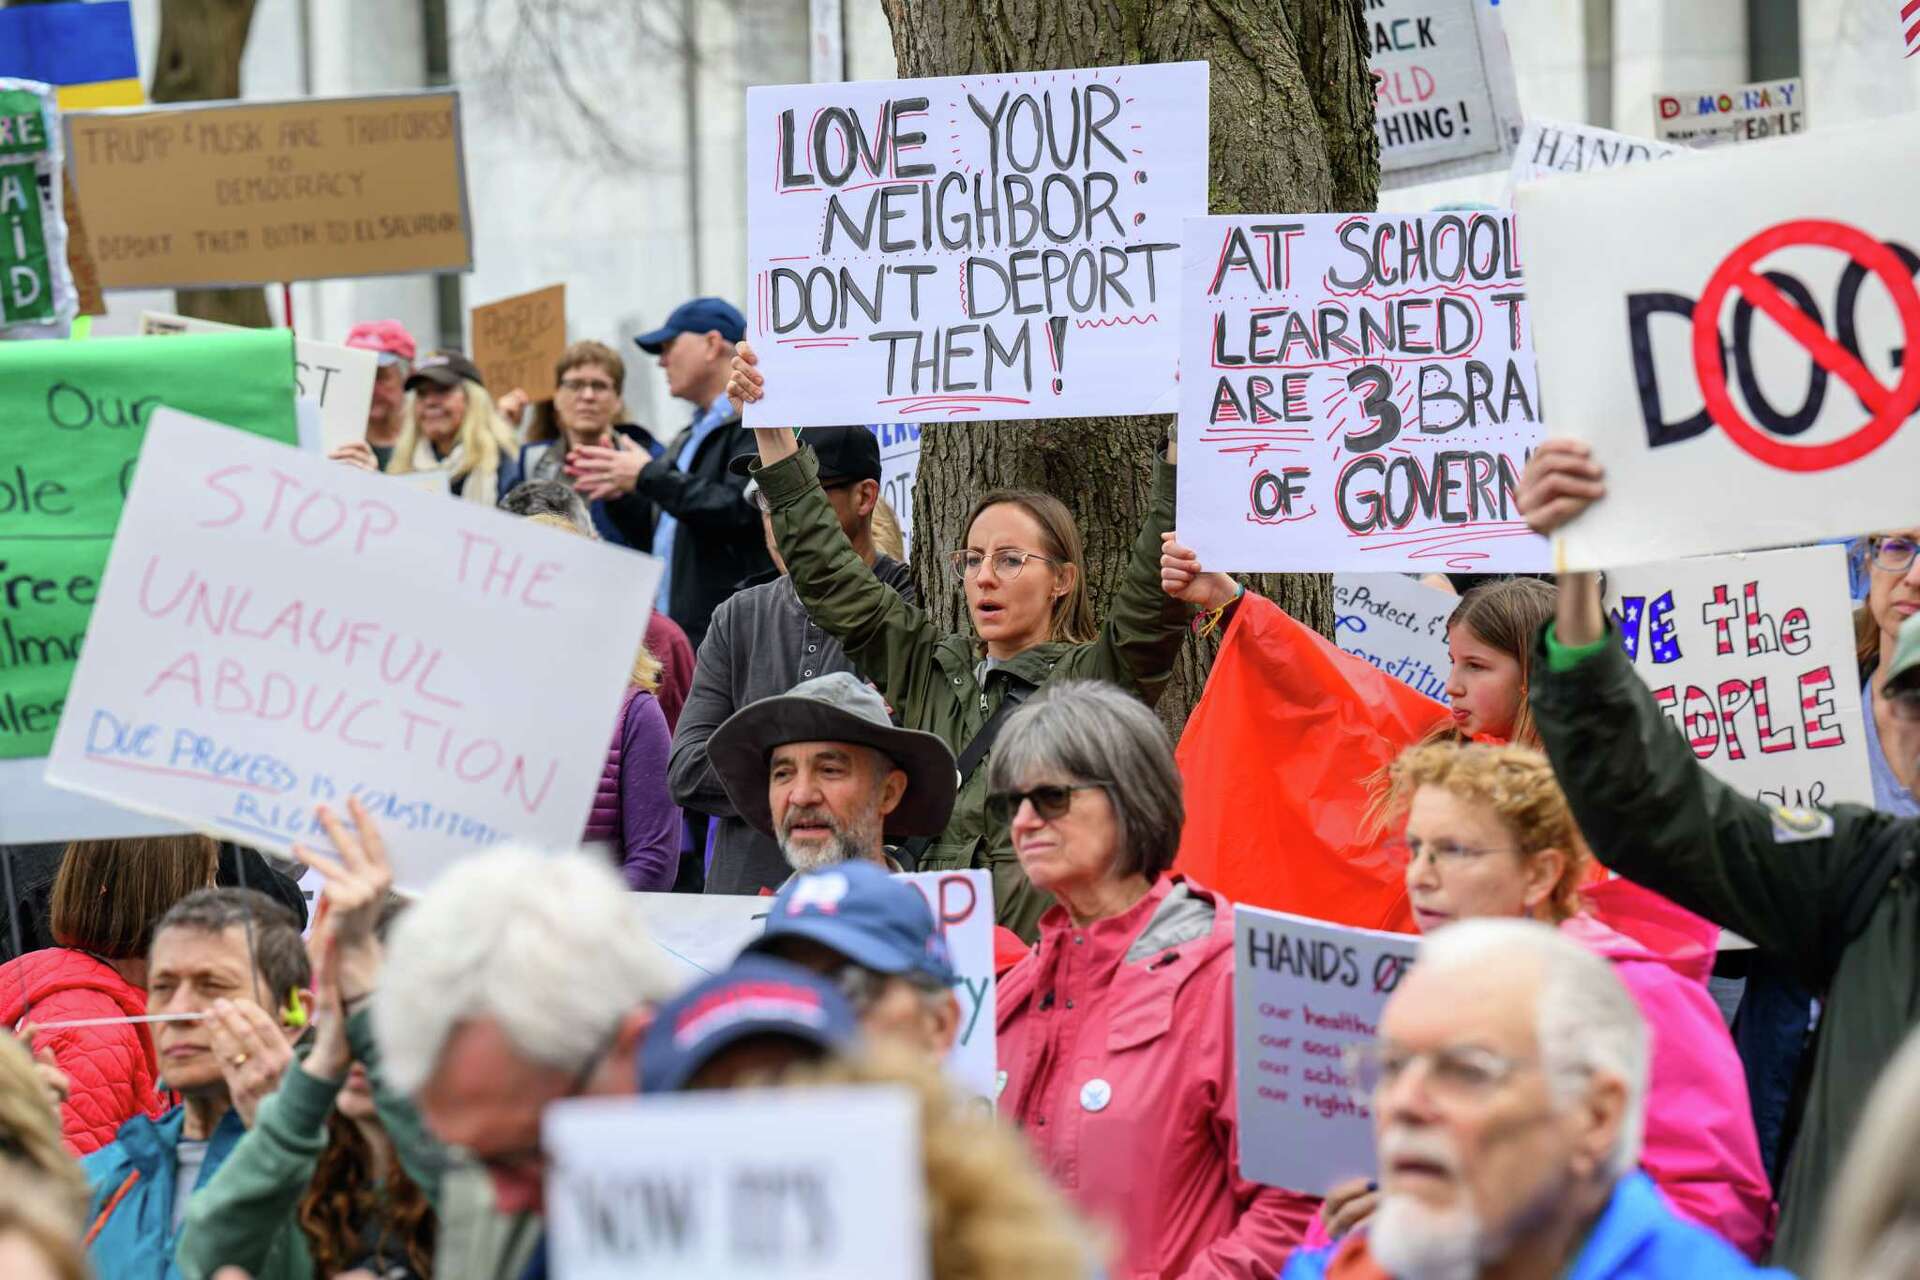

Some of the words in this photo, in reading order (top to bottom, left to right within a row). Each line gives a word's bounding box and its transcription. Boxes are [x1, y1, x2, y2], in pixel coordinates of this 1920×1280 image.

[1375, 17, 1436, 53] ACK
[81, 127, 174, 165] TRUMP
[198, 121, 264, 155] MUSK
[278, 117, 323, 150] ARE
[780, 96, 938, 188] LOVE
[967, 84, 1128, 176] YOUR
[1376, 101, 1471, 150] HING!
[215, 170, 367, 208] DEMOCRACY
[823, 169, 1149, 255] NEIGHBOR:
[770, 263, 938, 334] DON'T
[967, 243, 1182, 319] DEPORT
[1211, 222, 1305, 296] AT
[1328, 213, 1524, 291] SCHOOL
[1215, 296, 1476, 364] LEARNED
[46, 381, 163, 431] Our
[1209, 371, 1315, 425] ARE
[1344, 364, 1402, 452] 3
[1253, 467, 1312, 519] OF
[196, 464, 400, 555] STOP
[456, 528, 562, 610] THE
[0, 561, 97, 610] ree
[1702, 580, 1812, 656] the
[145, 650, 560, 815] ABDUCTION
[1247, 927, 1361, 988] HANDS
